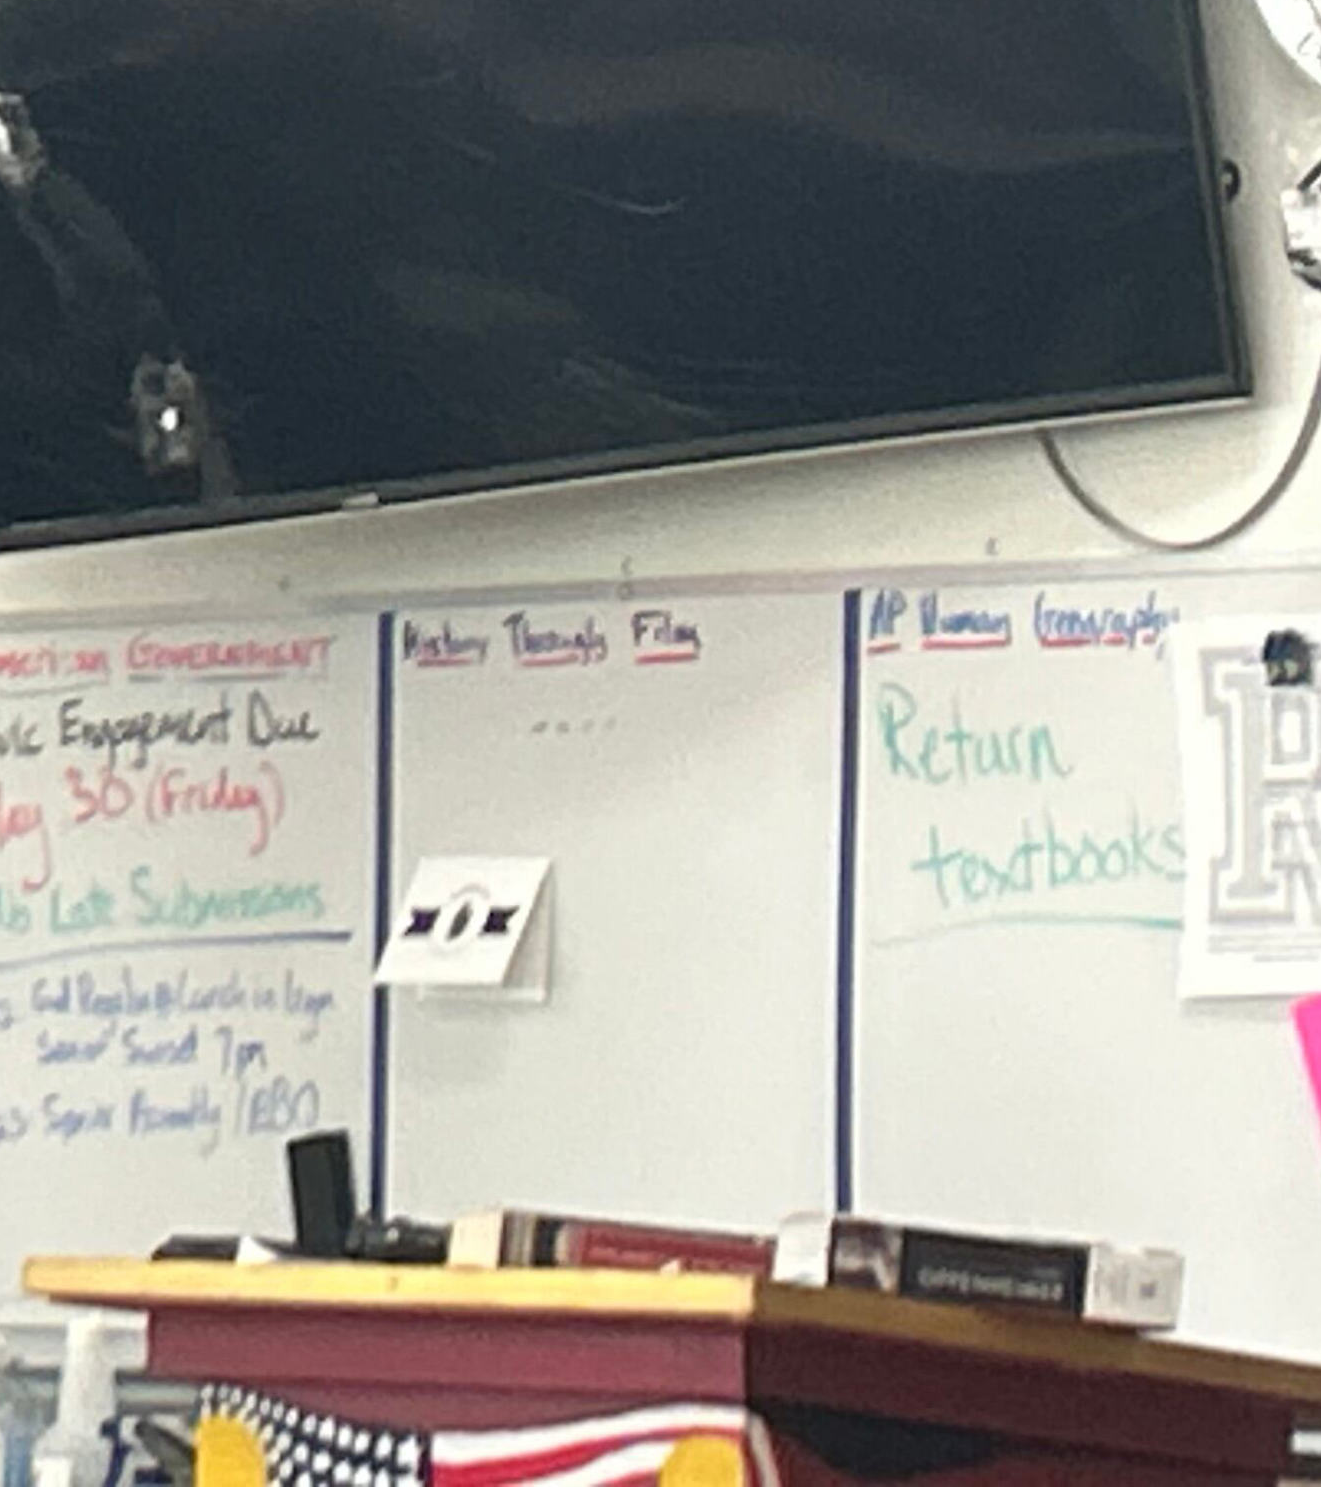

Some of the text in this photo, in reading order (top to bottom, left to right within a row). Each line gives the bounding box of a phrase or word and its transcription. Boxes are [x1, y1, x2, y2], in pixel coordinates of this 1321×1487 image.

[246, 689, 320, 748] Due
[876, 681, 1073, 785] Return
[64, 764, 137, 825] 30
[910, 795, 1187, 909] textbooks
